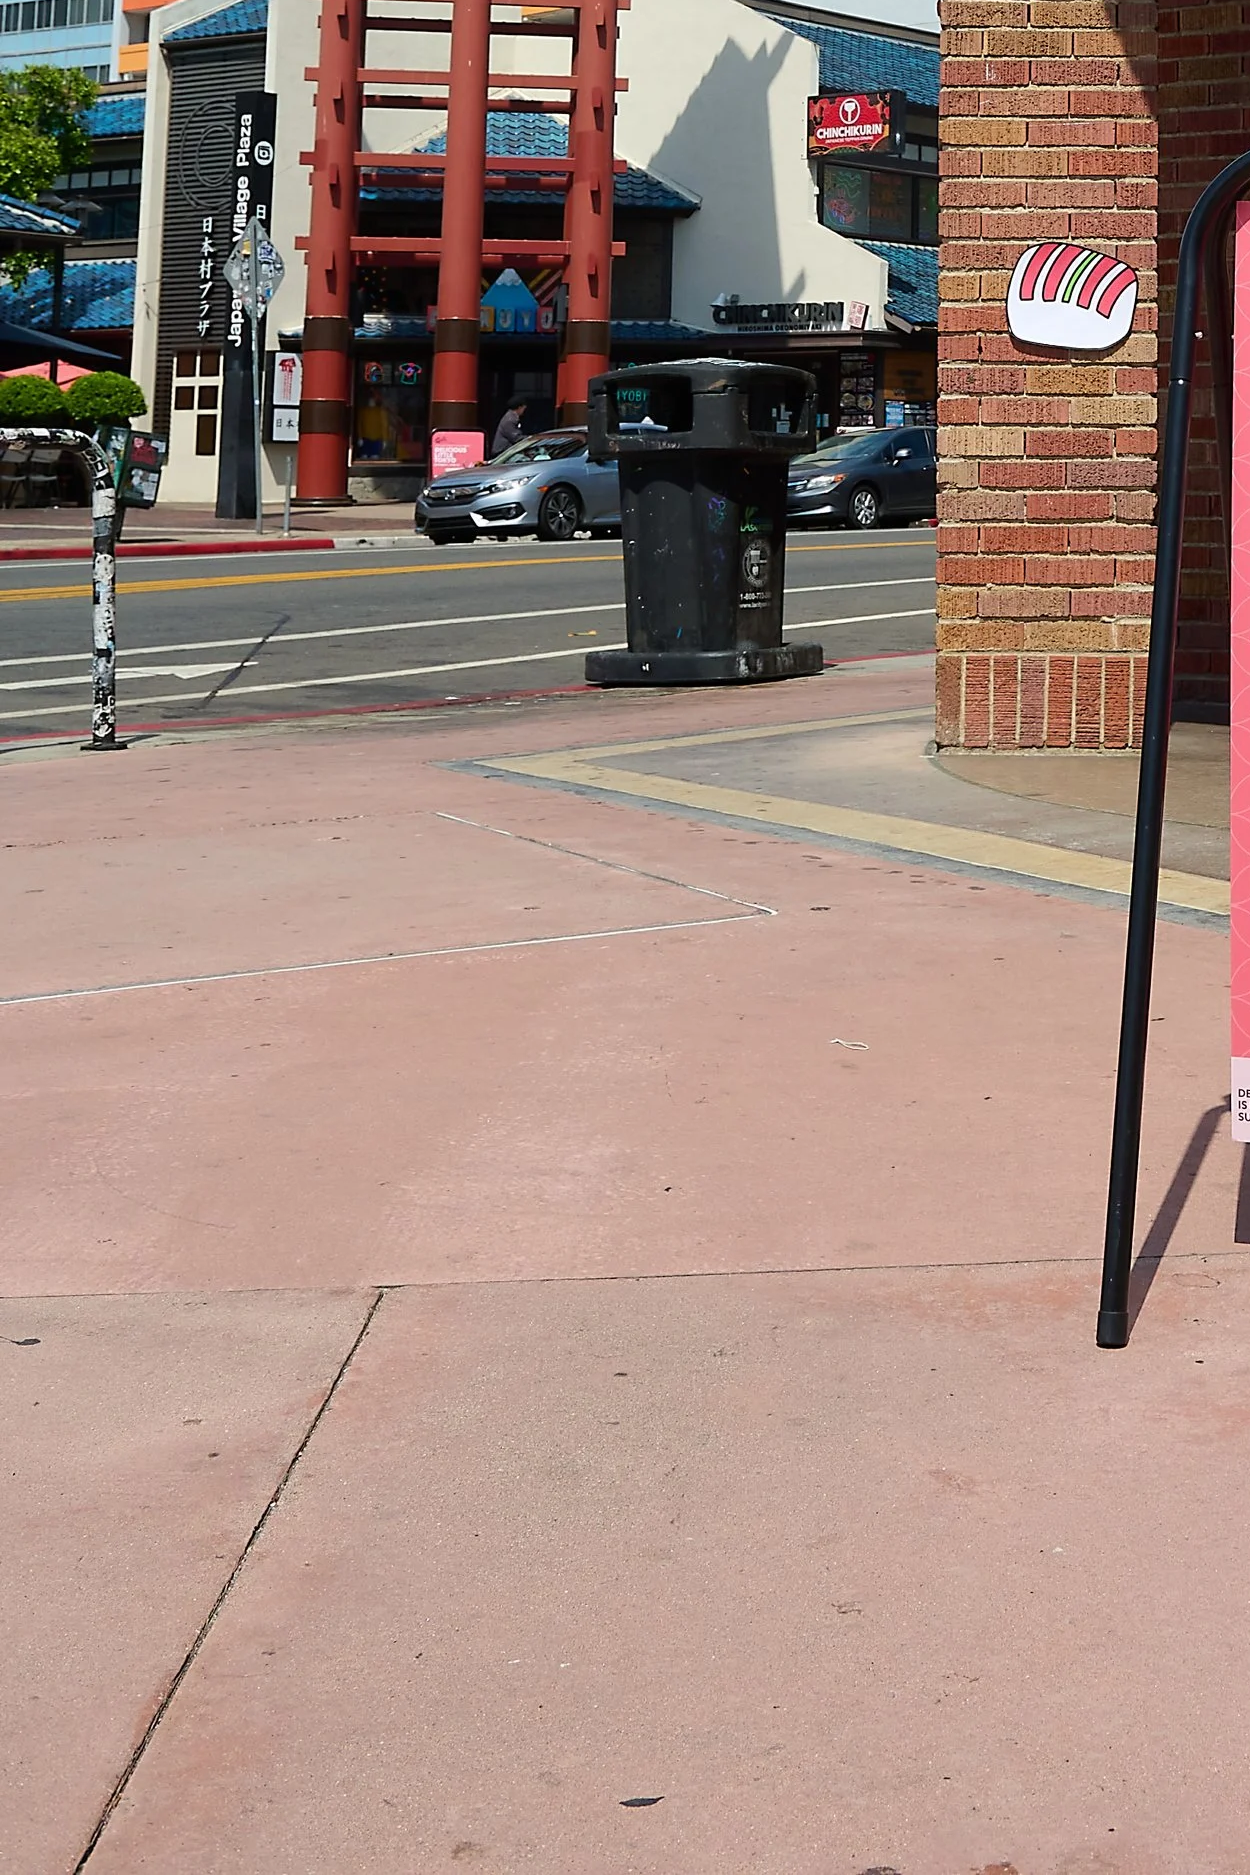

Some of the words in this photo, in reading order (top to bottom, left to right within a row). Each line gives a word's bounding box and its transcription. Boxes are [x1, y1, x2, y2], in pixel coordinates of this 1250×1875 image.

[236, 114, 253, 167] Plaza
[816, 124, 882, 139] CHINCHIKURIN
[232, 176, 251, 242] Village
[256, 205, 266, 219] 日
[197, 217, 215, 337] 日本村プラザ
[1238, 1100, 1248, 1110] IS
